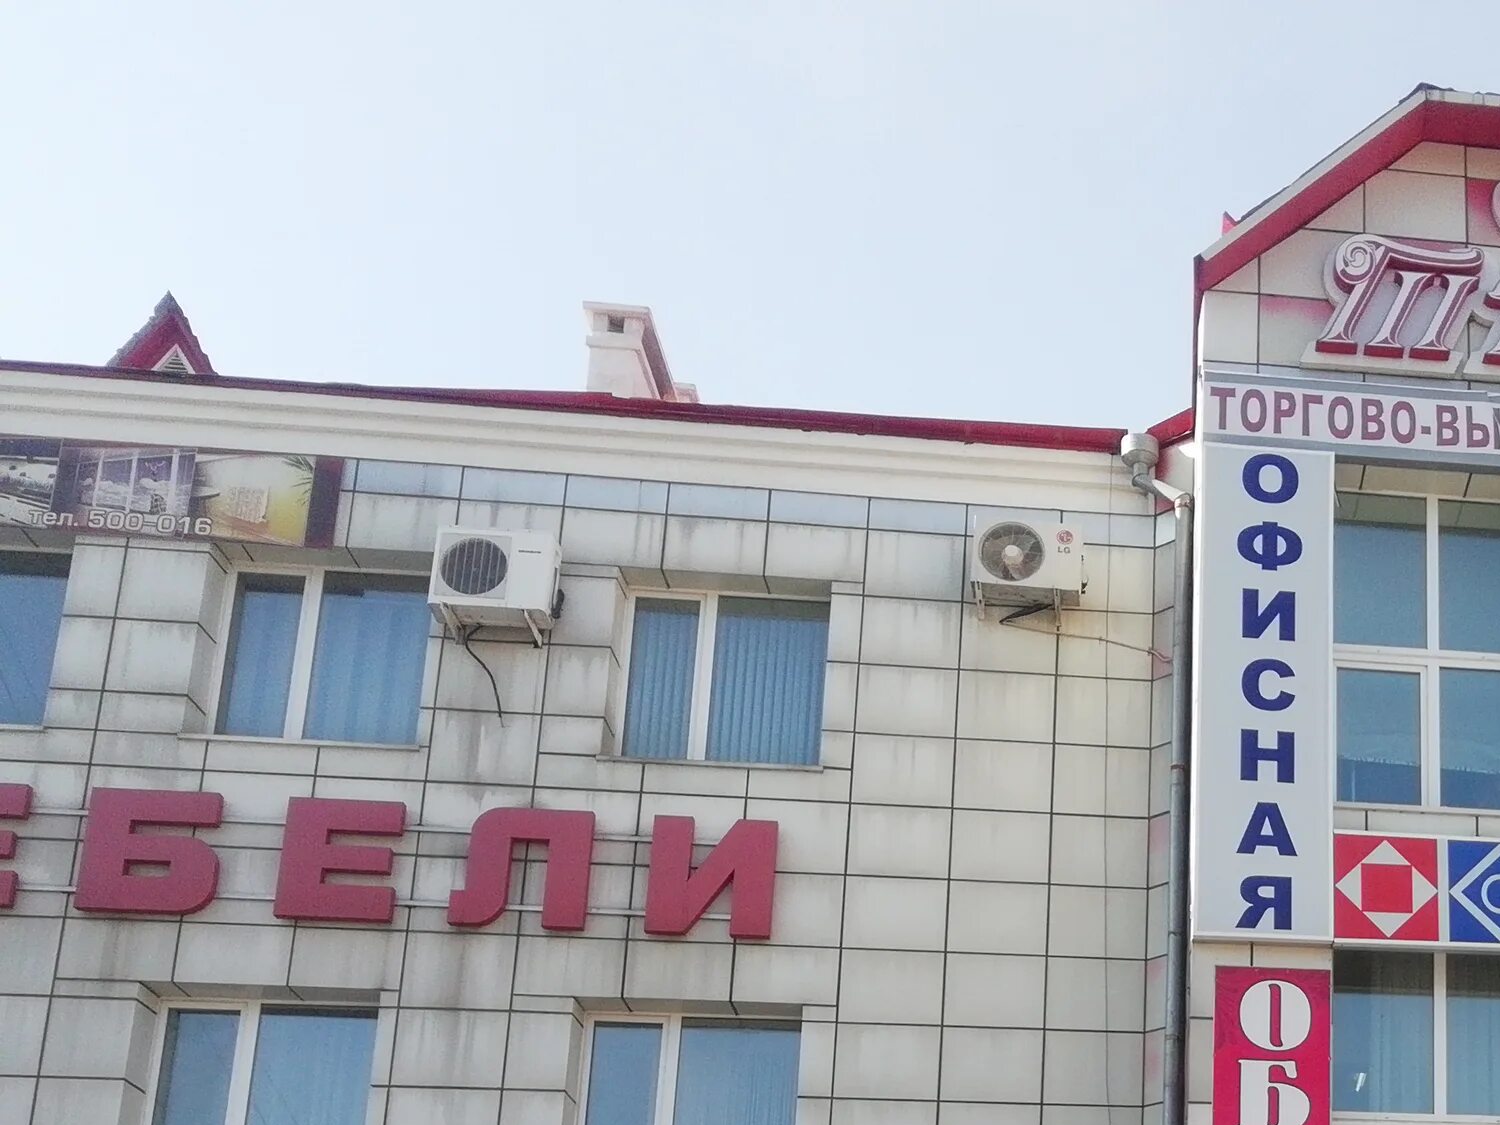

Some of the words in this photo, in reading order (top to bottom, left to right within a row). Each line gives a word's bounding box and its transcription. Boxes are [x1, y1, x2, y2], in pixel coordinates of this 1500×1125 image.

[28, 509, 80, 528] тел.
[87, 510, 213, 537] 500-016
[1057, 546, 1071, 554] LG
[1236, 453, 1304, 931] ОФИСНАЯ
[0, 784, 779, 940] БЕЛИ
